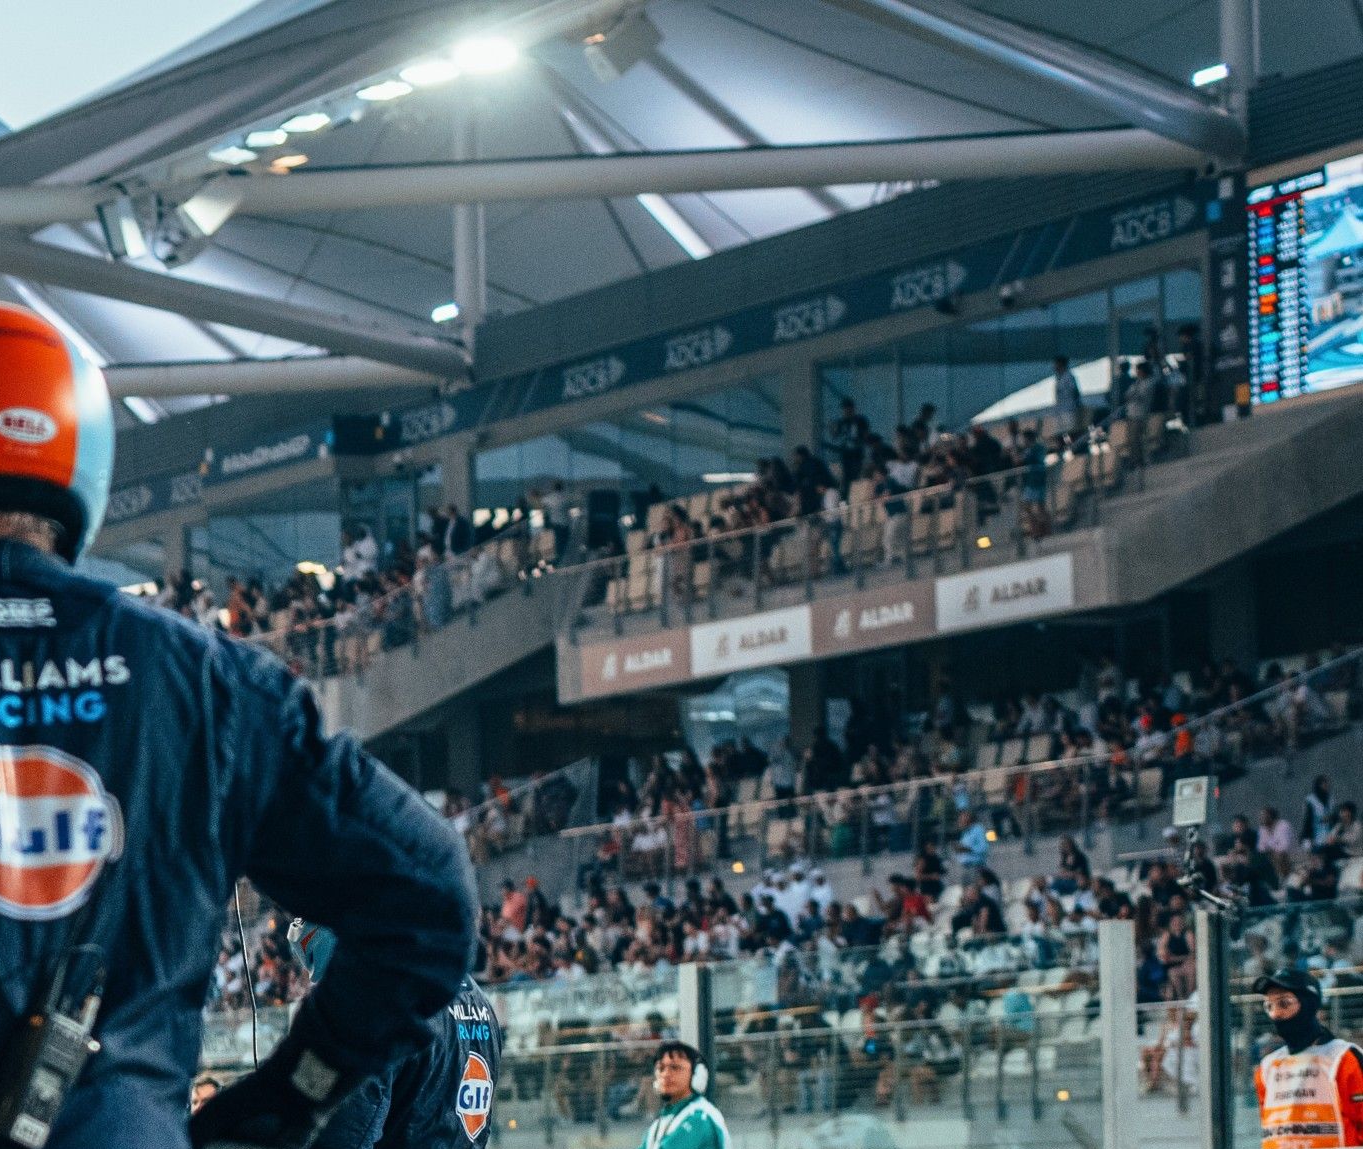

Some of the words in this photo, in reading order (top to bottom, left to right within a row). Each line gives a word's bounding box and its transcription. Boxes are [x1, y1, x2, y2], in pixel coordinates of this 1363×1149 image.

[990, 577, 1047, 606] ALDAR
[859, 603, 914, 629] ALDAR
[737, 627, 789, 652] ALDAR
[624, 648, 672, 673] ALDAR
